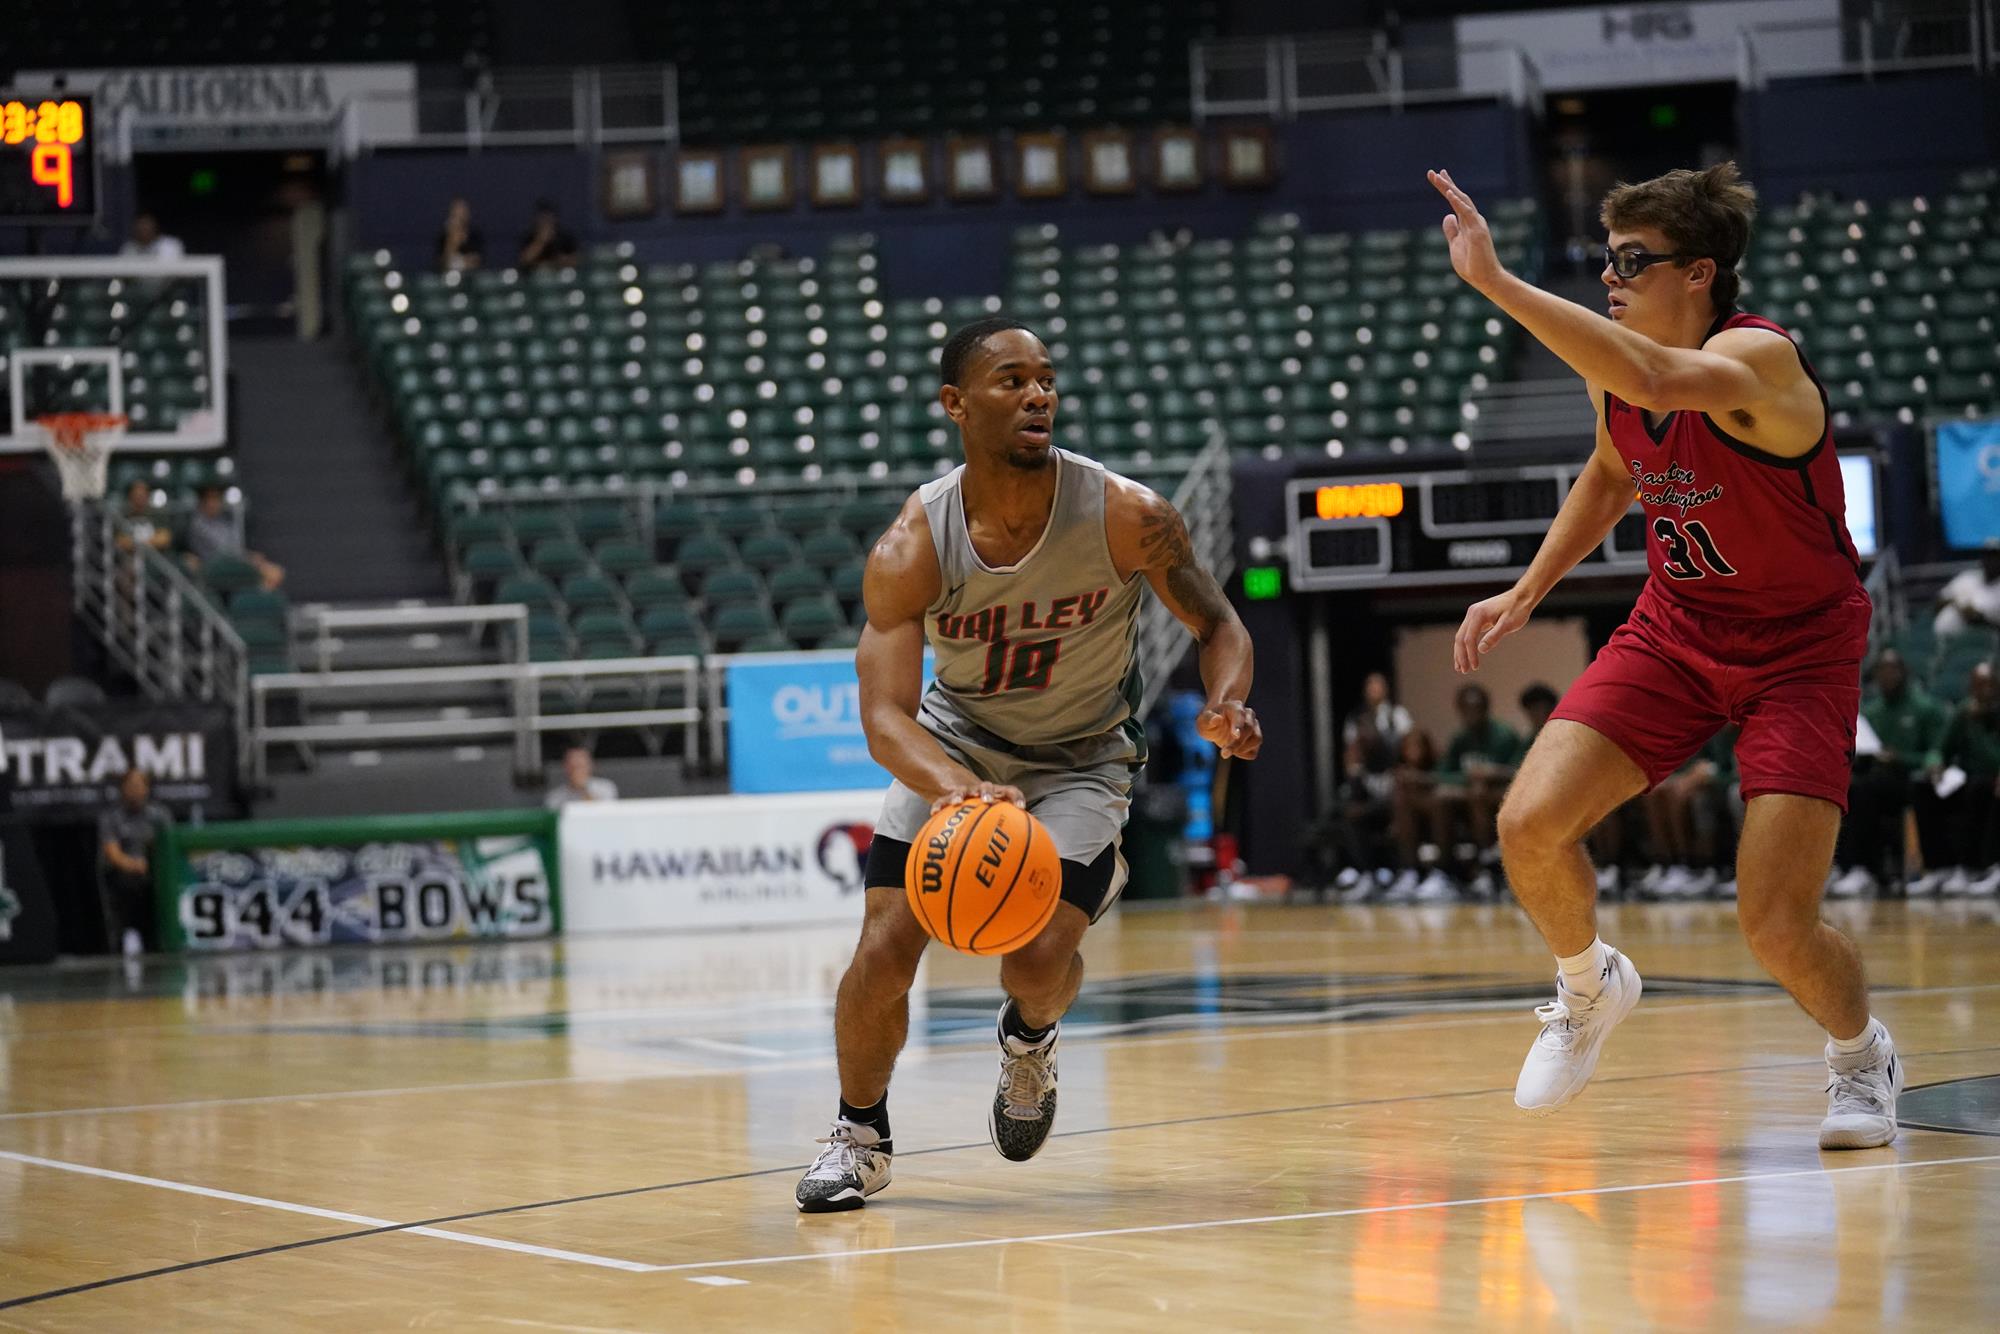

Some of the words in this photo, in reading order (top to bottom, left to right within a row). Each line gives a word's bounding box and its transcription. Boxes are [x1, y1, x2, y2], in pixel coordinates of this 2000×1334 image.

[32, 142, 73, 208] 9
[1652, 516, 1738, 580] 31
[936, 586, 1110, 644] VALLEY
[979, 637, 1062, 695] 10
[590, 847, 804, 882] HAWAIIAN
[922, 803, 977, 895] Wilson
[188, 880, 328, 942] 944
[376, 875, 545, 935] BOWS
